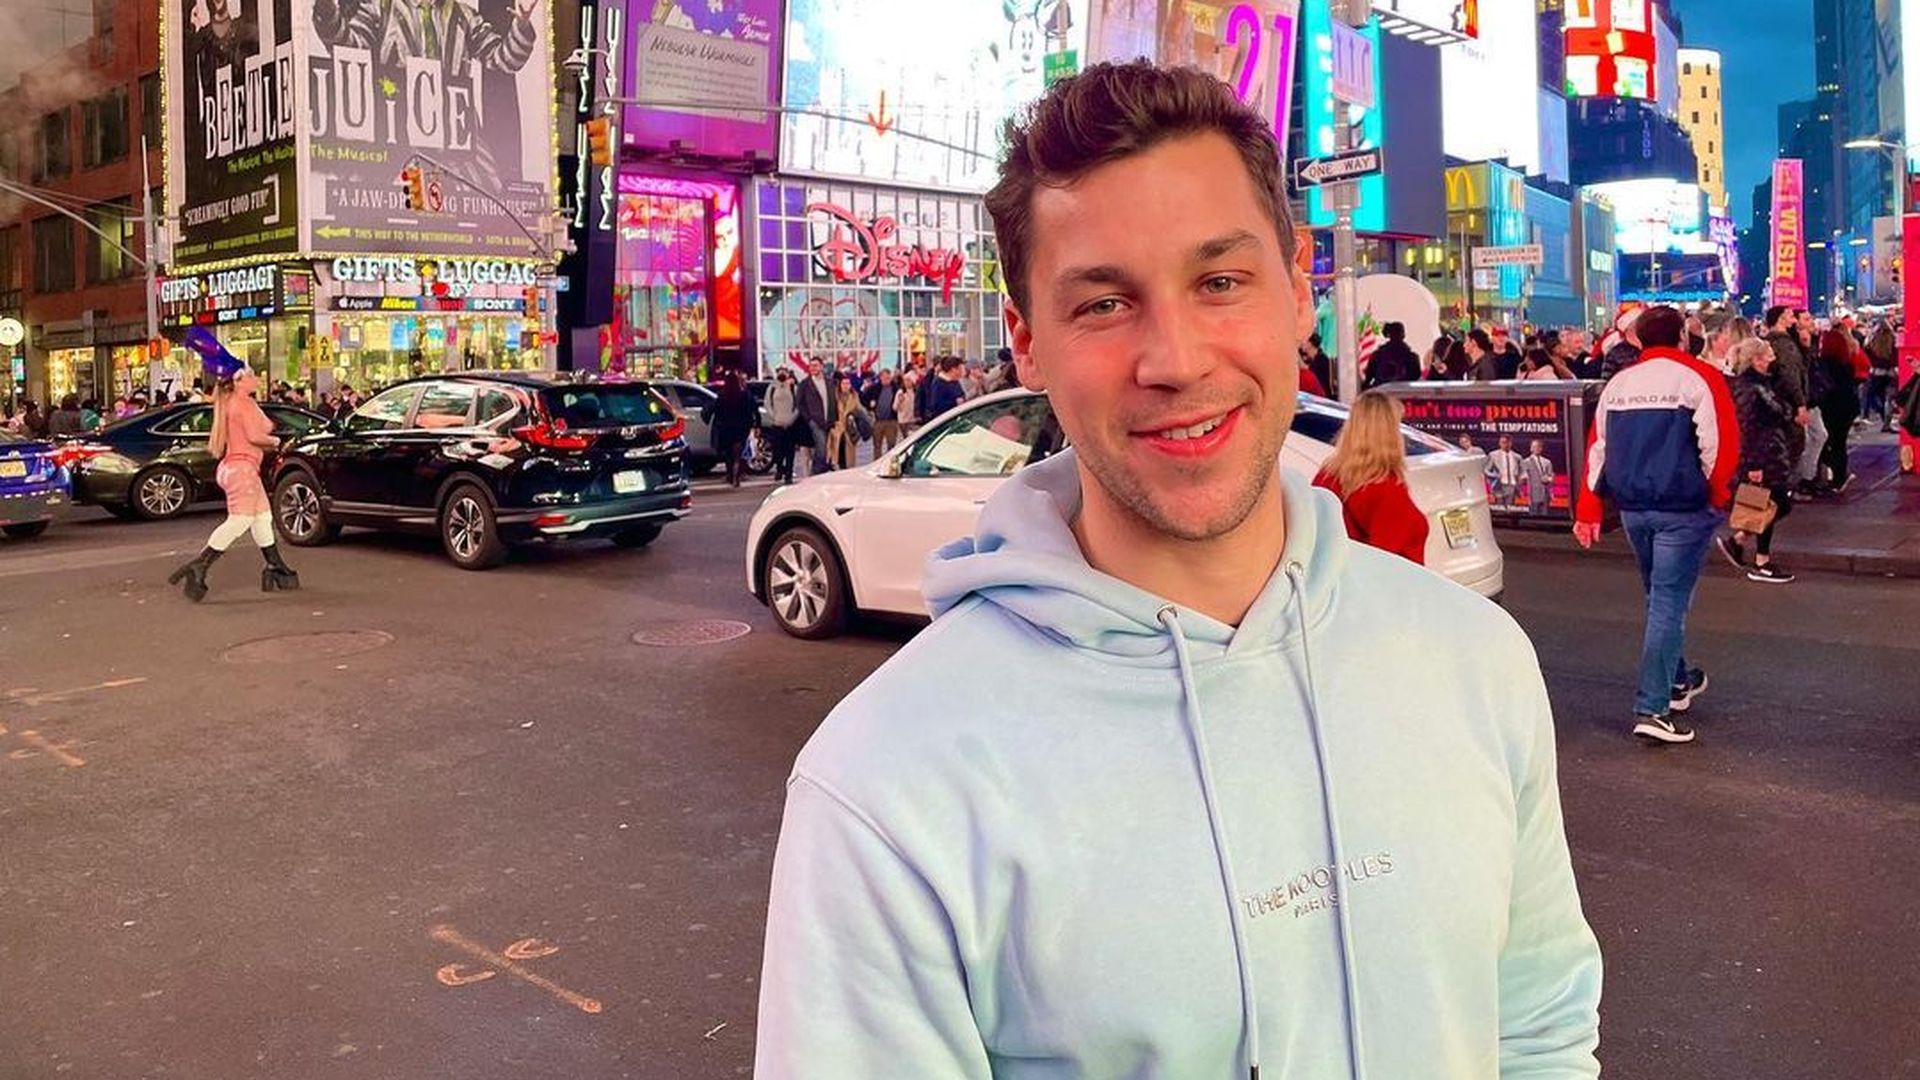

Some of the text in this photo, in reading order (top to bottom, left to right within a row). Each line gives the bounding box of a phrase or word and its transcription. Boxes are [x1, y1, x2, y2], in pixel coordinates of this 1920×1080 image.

[1225, 4, 1293, 157] 21
[203, 55, 292, 159] BEETLE
[308, 59, 472, 151] JUICE
[310, 144, 387, 162] The Musical
[1309, 155, 1371, 179] ONE WAY
[807, 201, 967, 306] Disney
[1778, 205, 1796, 279] WISH
[331, 258, 416, 283] GIFTS
[161, 277, 199, 303] GIFTS
[473, 298, 515, 311] SONY
[1485, 401, 1557, 422] proud
[1480, 422, 1498, 433] THE
